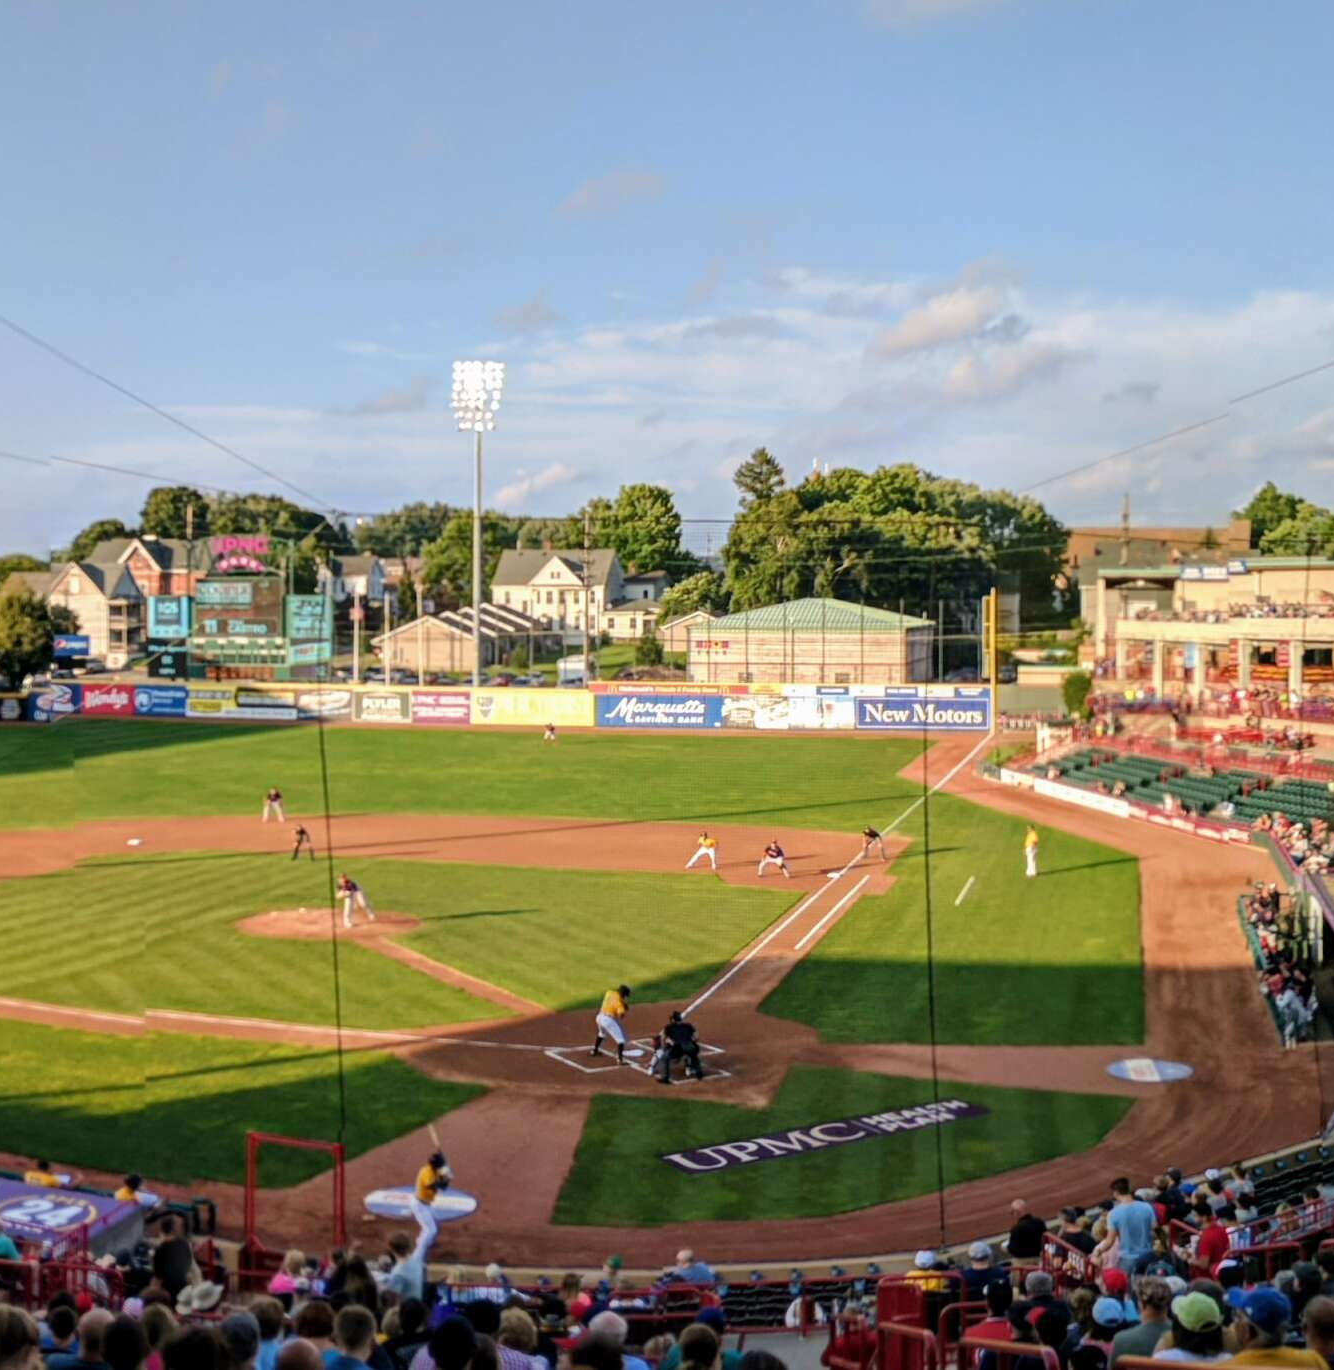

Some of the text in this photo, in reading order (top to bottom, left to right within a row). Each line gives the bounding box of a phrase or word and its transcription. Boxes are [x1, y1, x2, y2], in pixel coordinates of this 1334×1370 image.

[605, 697, 706, 722] Marquette
[864, 703, 983, 724] New Motors
[861, 1099, 970, 1126] HEALTH
[876, 1112, 956, 1133] PLAN
[662, 1121, 866, 1171] UPMC
[0, 1199, 84, 1227] 24
